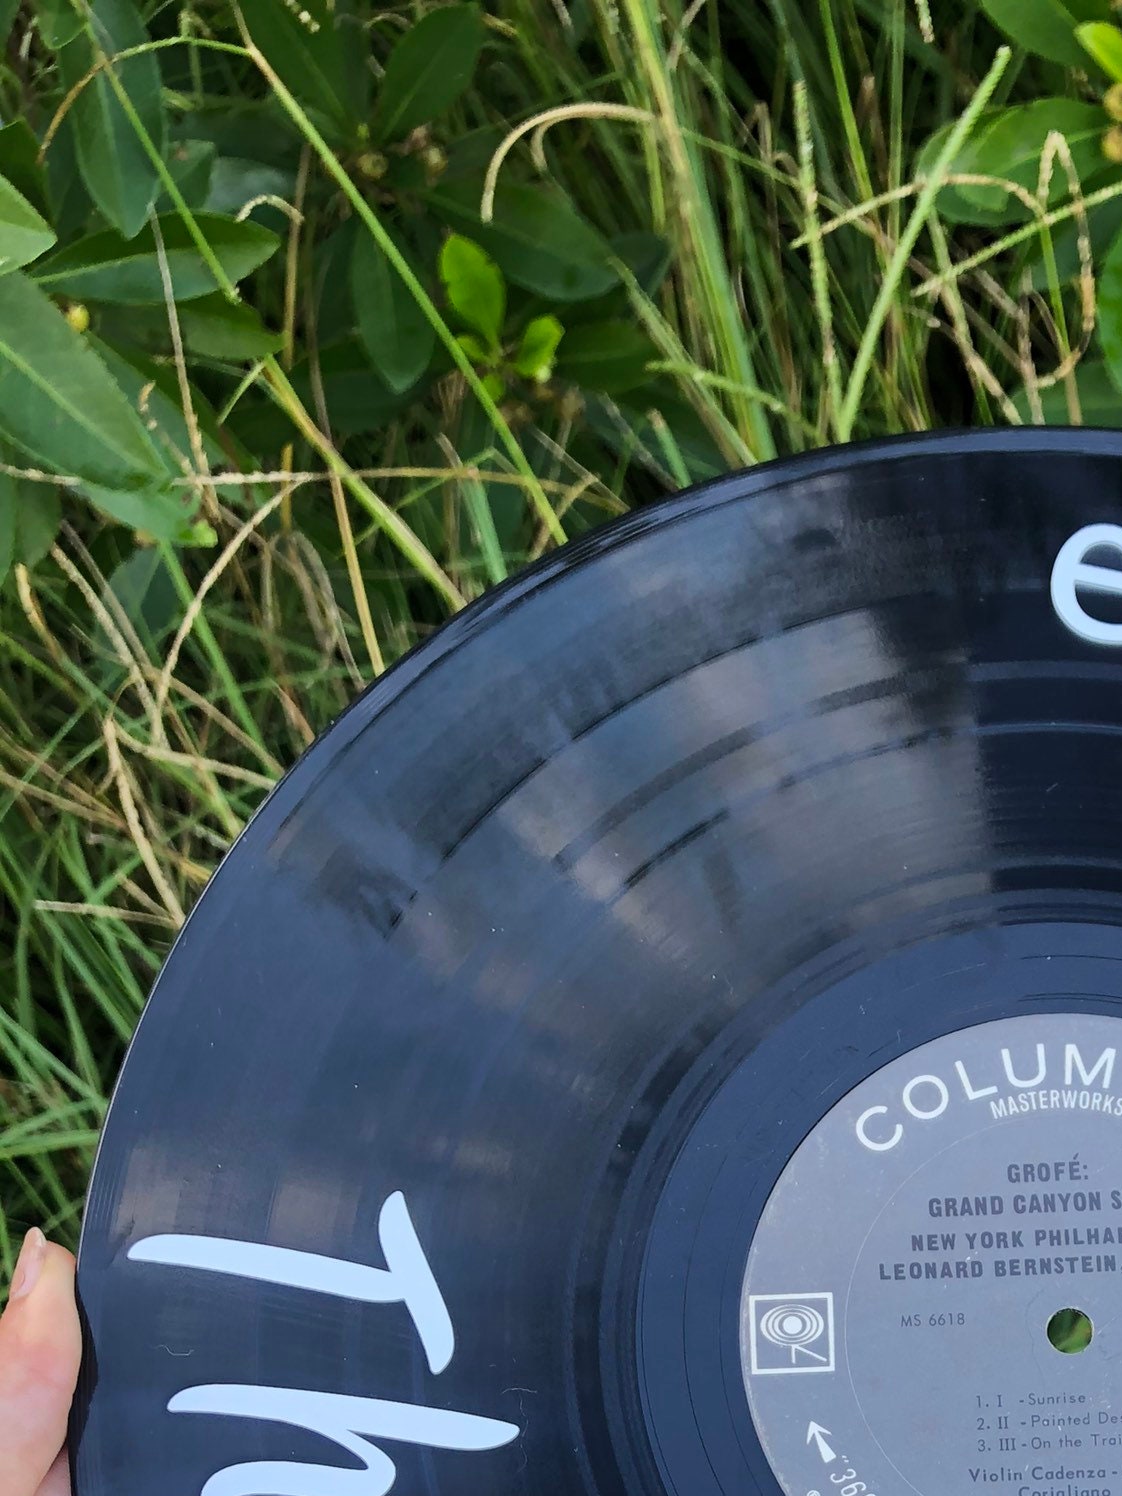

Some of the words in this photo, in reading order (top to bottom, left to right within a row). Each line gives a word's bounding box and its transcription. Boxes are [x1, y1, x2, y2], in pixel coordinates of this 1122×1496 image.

[1006, 1153, 1089, 1183] GROFÉ:
[928, 1195, 1004, 1218] GRAND
[1012, 1190, 1101, 1214] CANYON
[911, 1233, 956, 1252] NEW
[965, 1230, 1024, 1250] YORK
[879, 1260, 984, 1280] LEONARD
[900, 1314, 923, 1328] MS
[928, 1312, 966, 1327] 6618
[976, 1395, 989, 1408] 1.
[976, 1417, 991, 1431] 2.
[977, 1439, 992, 1452] 3.
[1059, 1434, 1083, 1448] the
[968, 1467, 1023, 1483] Violin
[1031, 1465, 1106, 1482] Cadenza
